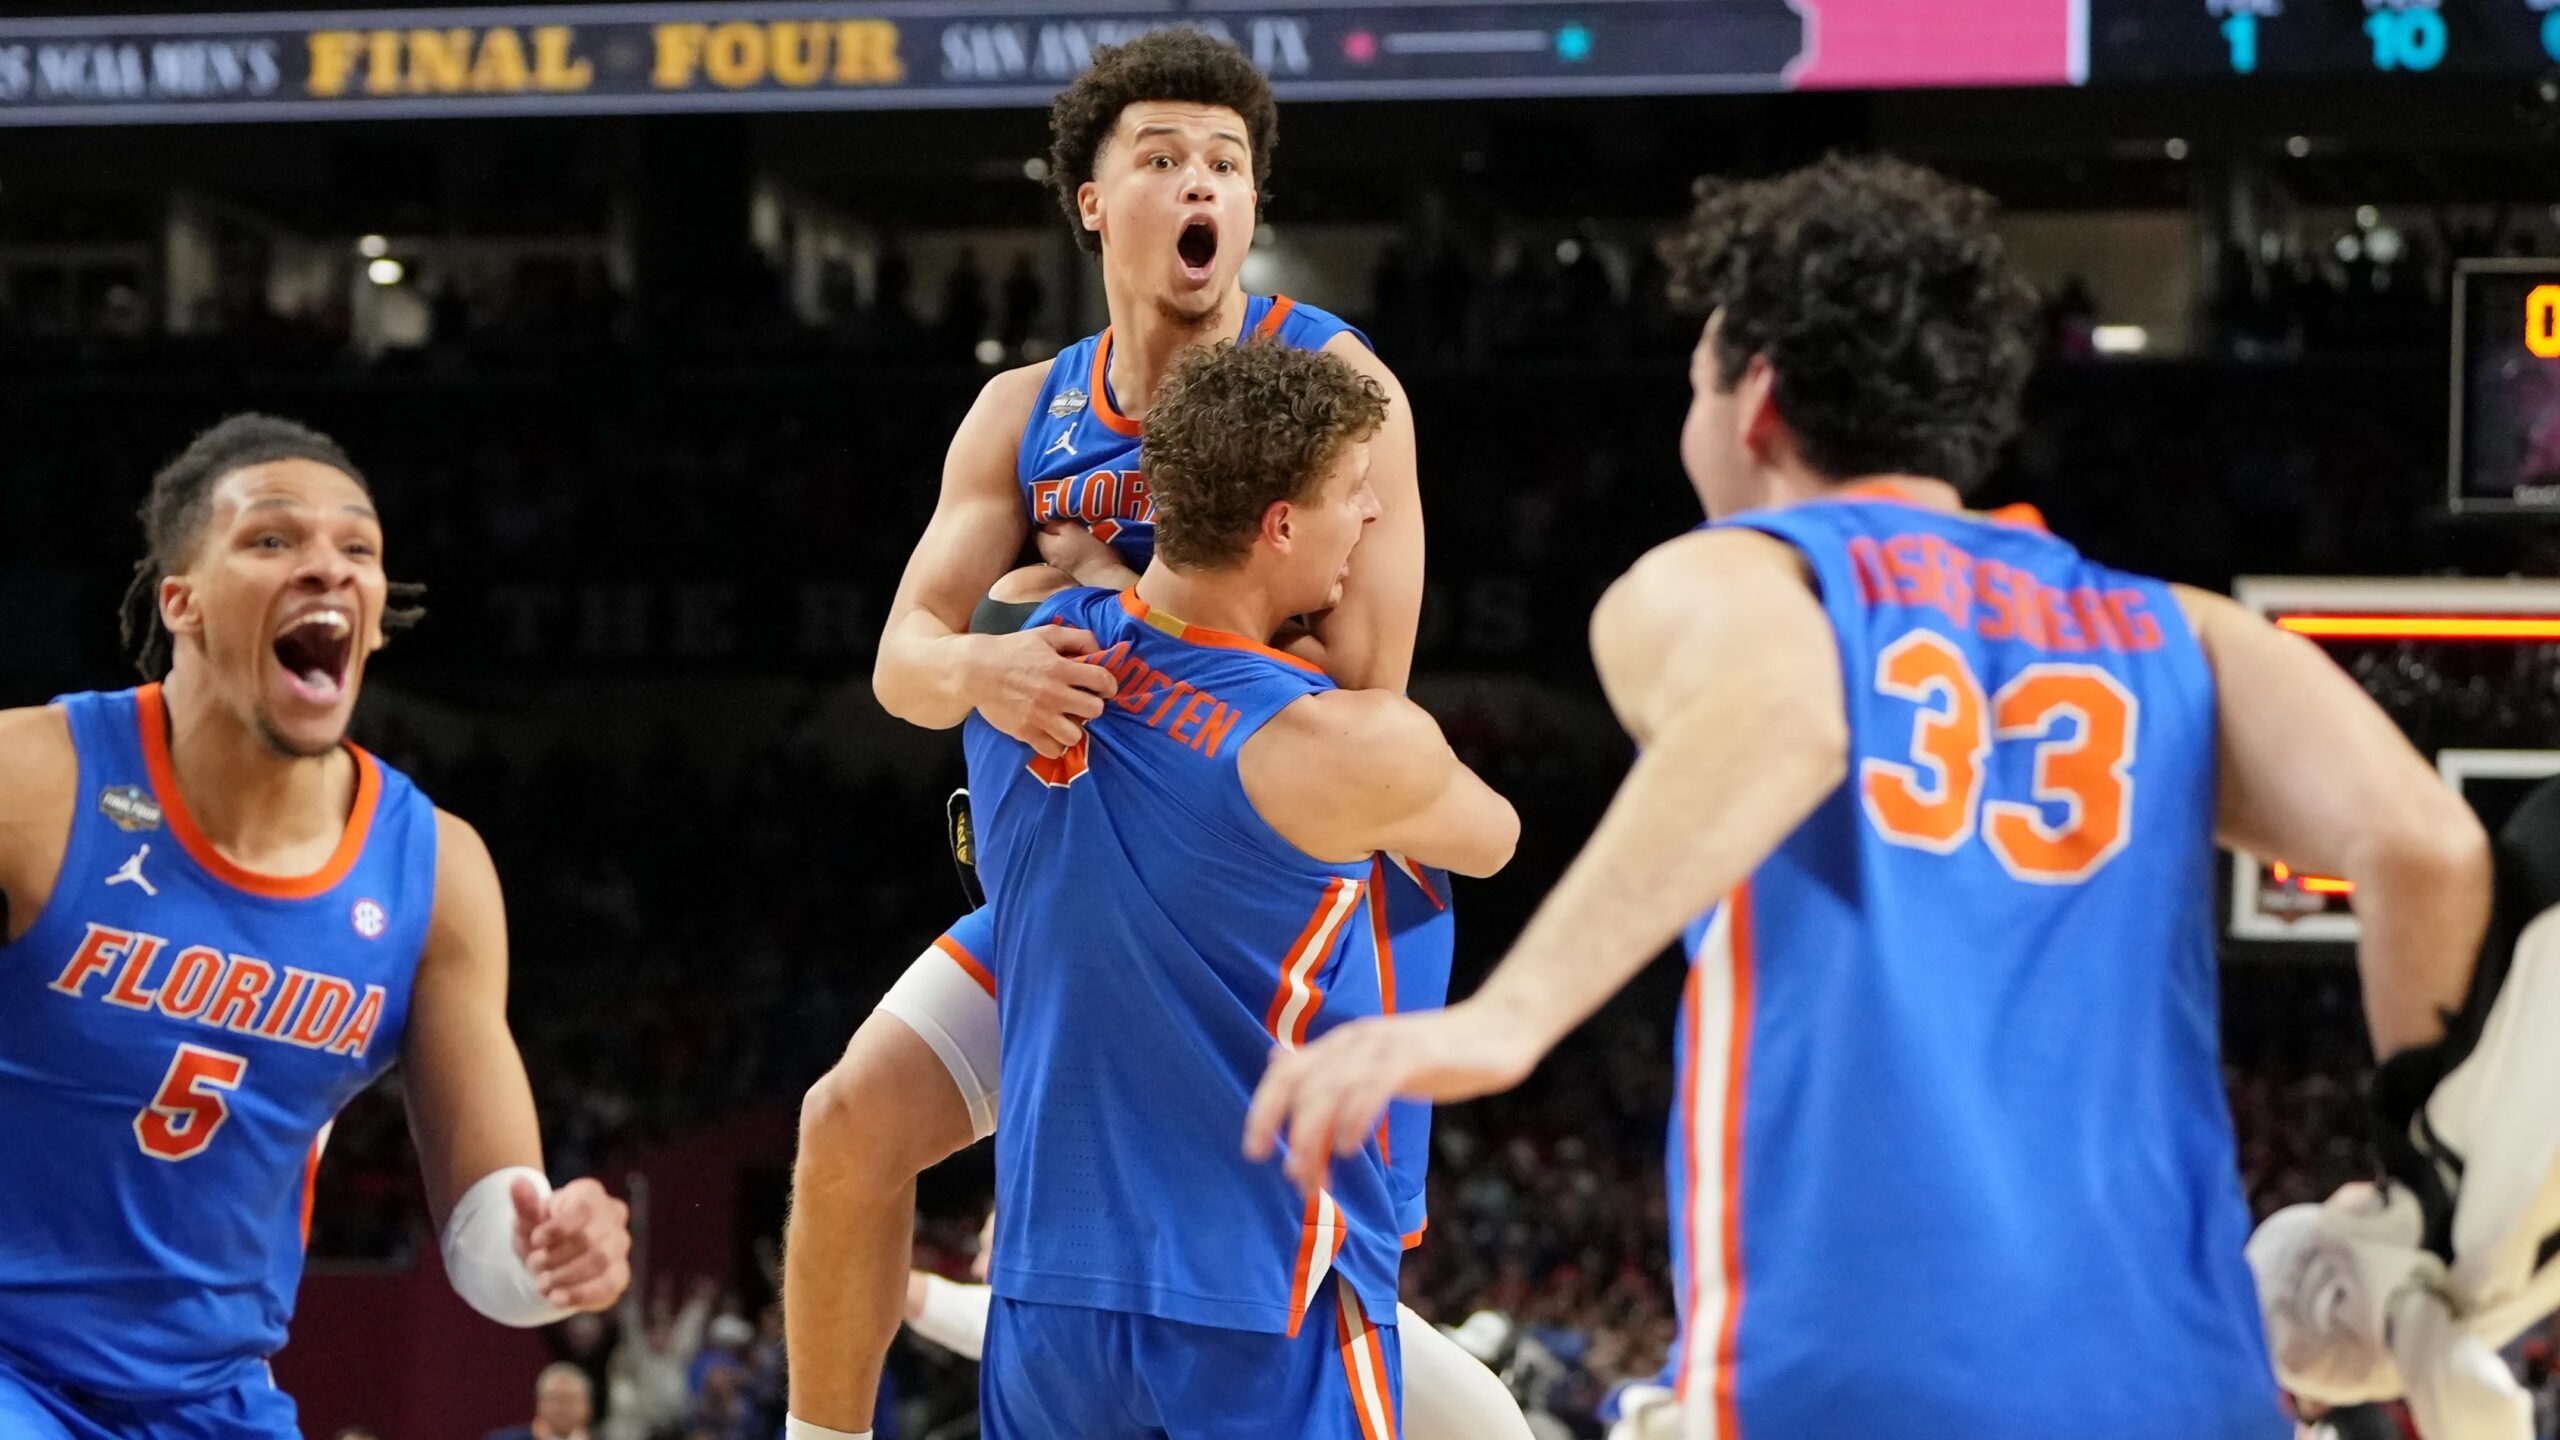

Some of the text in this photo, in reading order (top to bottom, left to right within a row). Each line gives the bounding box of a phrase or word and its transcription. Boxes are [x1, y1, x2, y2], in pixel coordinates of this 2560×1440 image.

[305, 26, 595, 97] FINAL
[649, 18, 906, 89] FOUR
[2219, 9, 2260, 74] 1
[2361, 6, 2447, 72] 10
[1029, 469, 1161, 525] FLOR
[1860, 627, 2140, 886] 33
[47, 922, 387, 1059] FLORIDA
[132, 1041, 249, 1162] 5
